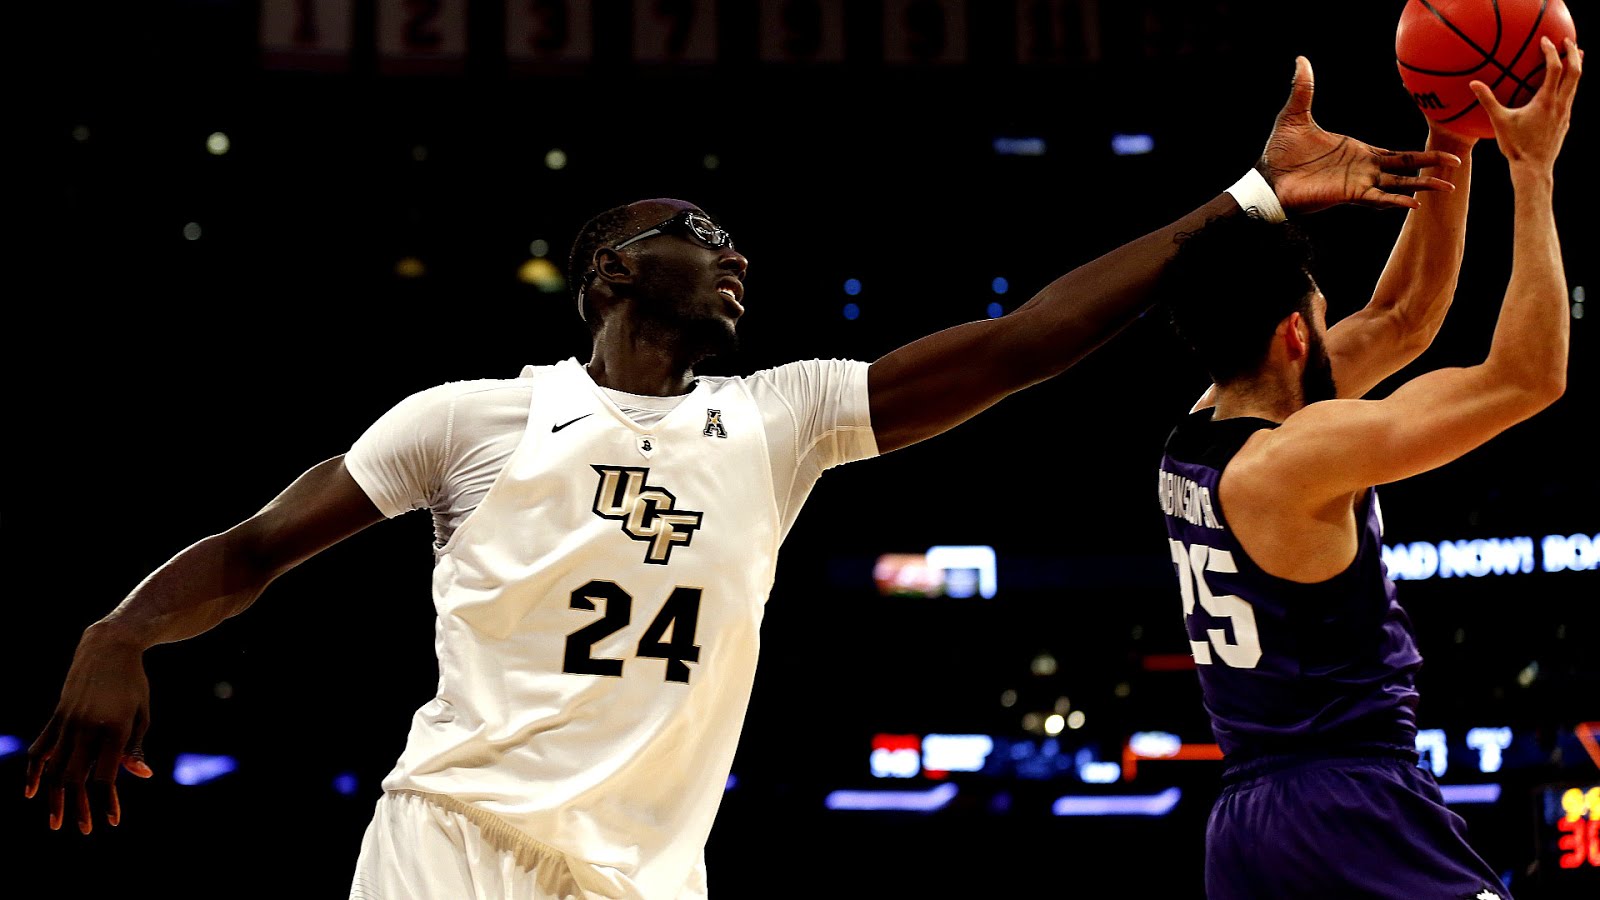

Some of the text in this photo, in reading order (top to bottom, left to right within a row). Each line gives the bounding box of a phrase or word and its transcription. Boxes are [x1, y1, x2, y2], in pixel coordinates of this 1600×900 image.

[590, 464, 703, 565] UCF
[562, 579, 703, 685] 24
[1168, 538, 1263, 668] 25
